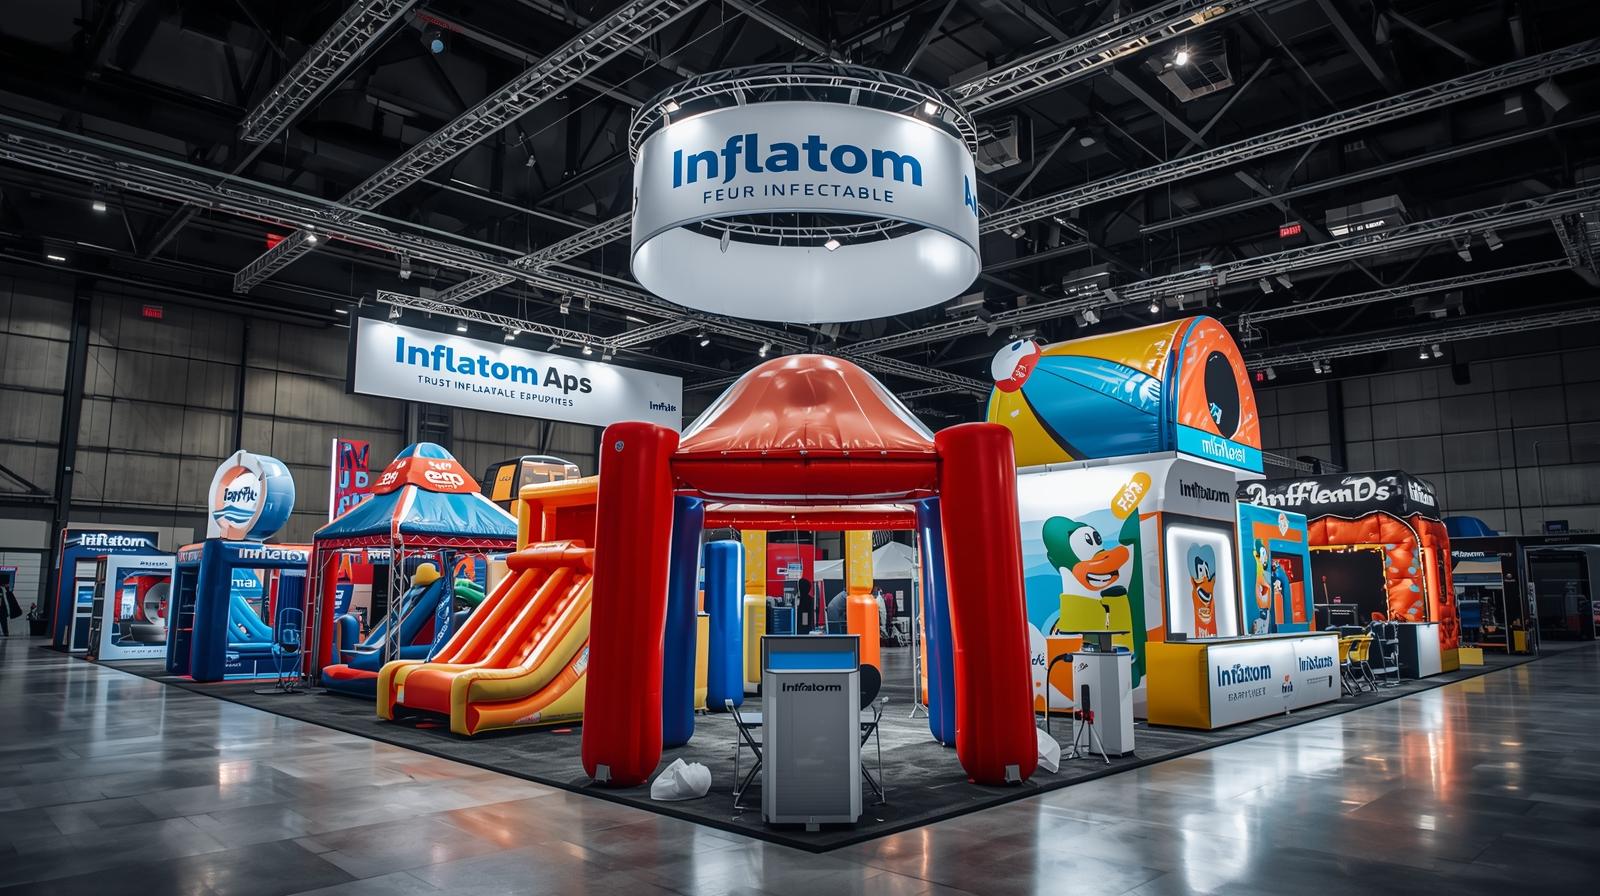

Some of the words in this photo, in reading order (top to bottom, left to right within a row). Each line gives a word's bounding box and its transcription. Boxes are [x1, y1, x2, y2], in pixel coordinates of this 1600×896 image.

[673, 133, 923, 189] Inflatom
[703, 184, 755, 204] FEUR
[764, 183, 894, 203] INFECTABLE
[395, 336, 538, 386] Inflatom
[542, 366, 593, 395] Aps
[418, 375, 451, 388] TRUST
